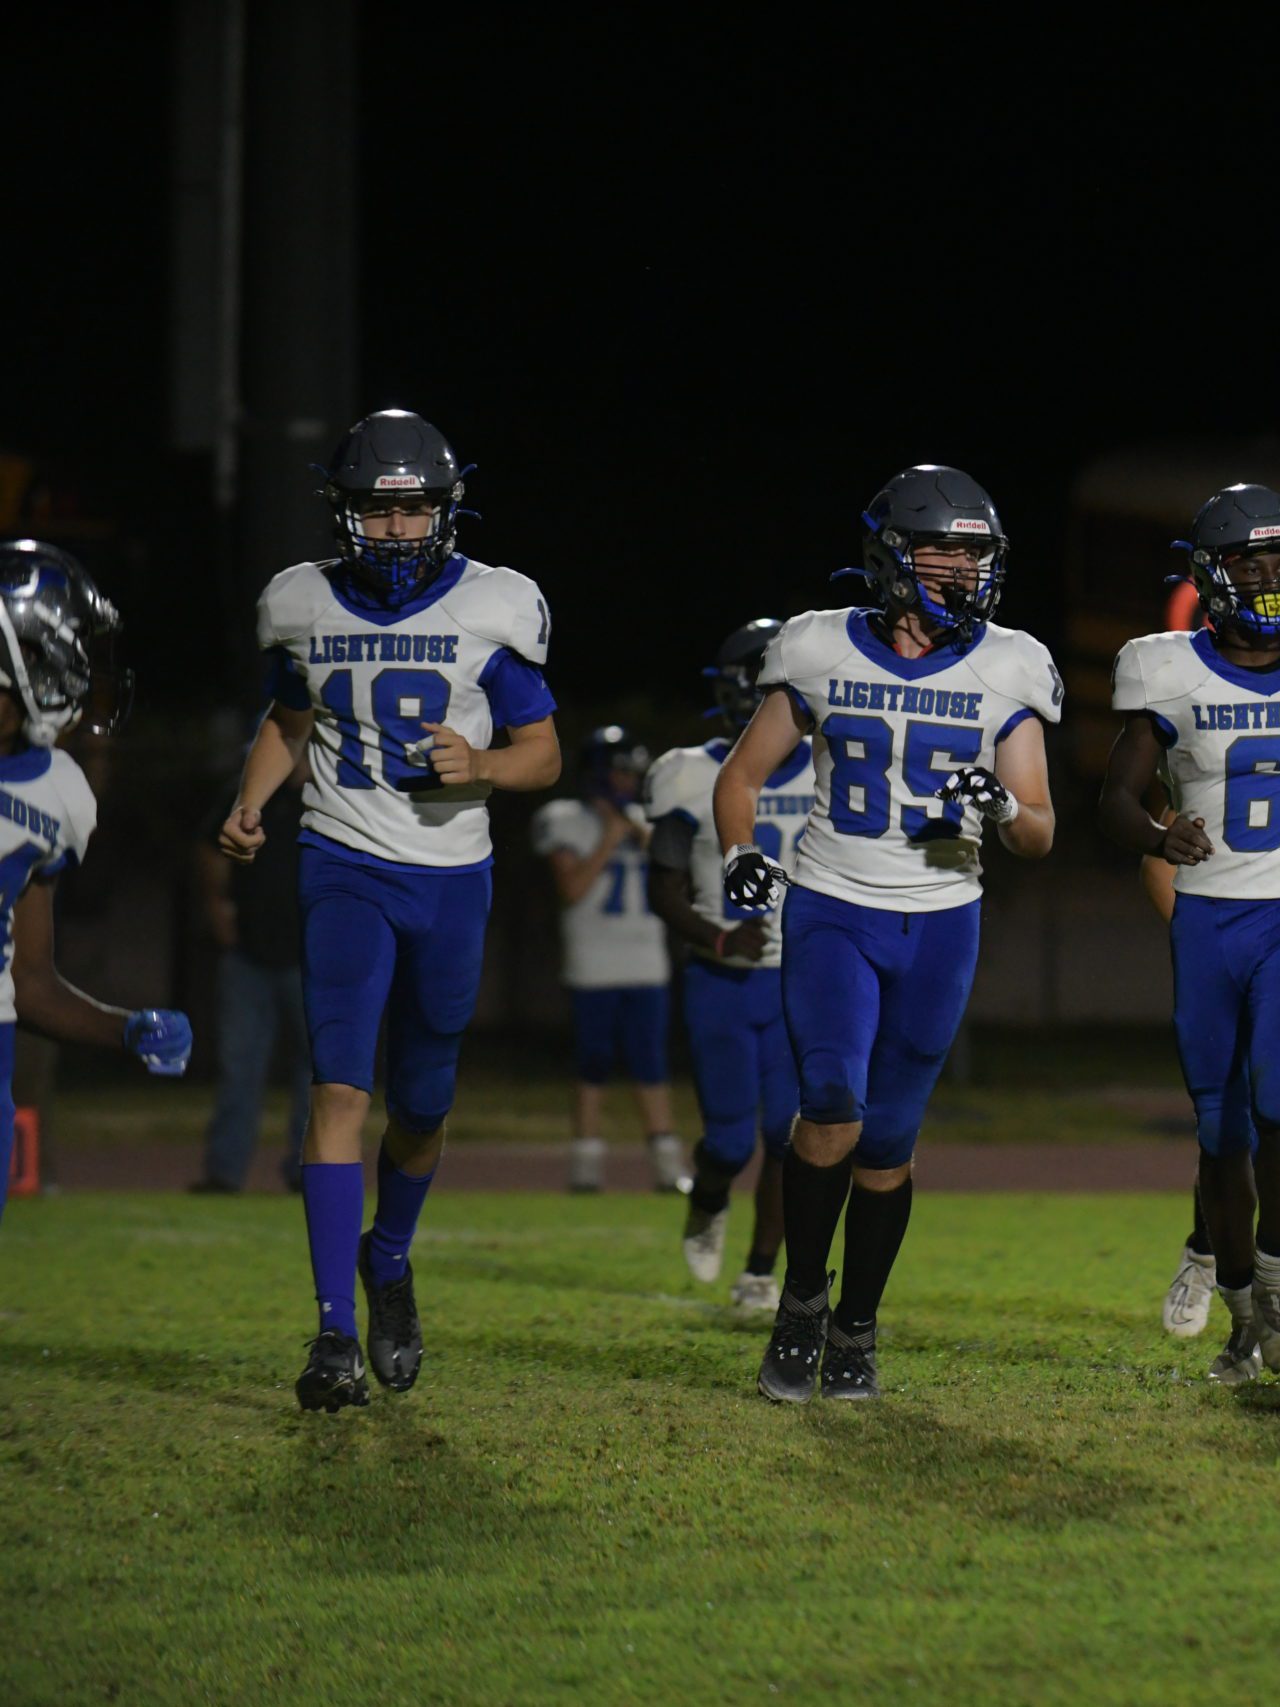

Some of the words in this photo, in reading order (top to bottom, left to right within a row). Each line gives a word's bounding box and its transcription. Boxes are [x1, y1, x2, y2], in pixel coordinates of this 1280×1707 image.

[309, 633, 459, 664] LIGHTHOUSE
[321, 668, 451, 793] 18
[829, 678, 983, 721] LIGHTHOUSE
[822, 712, 984, 844] 85
